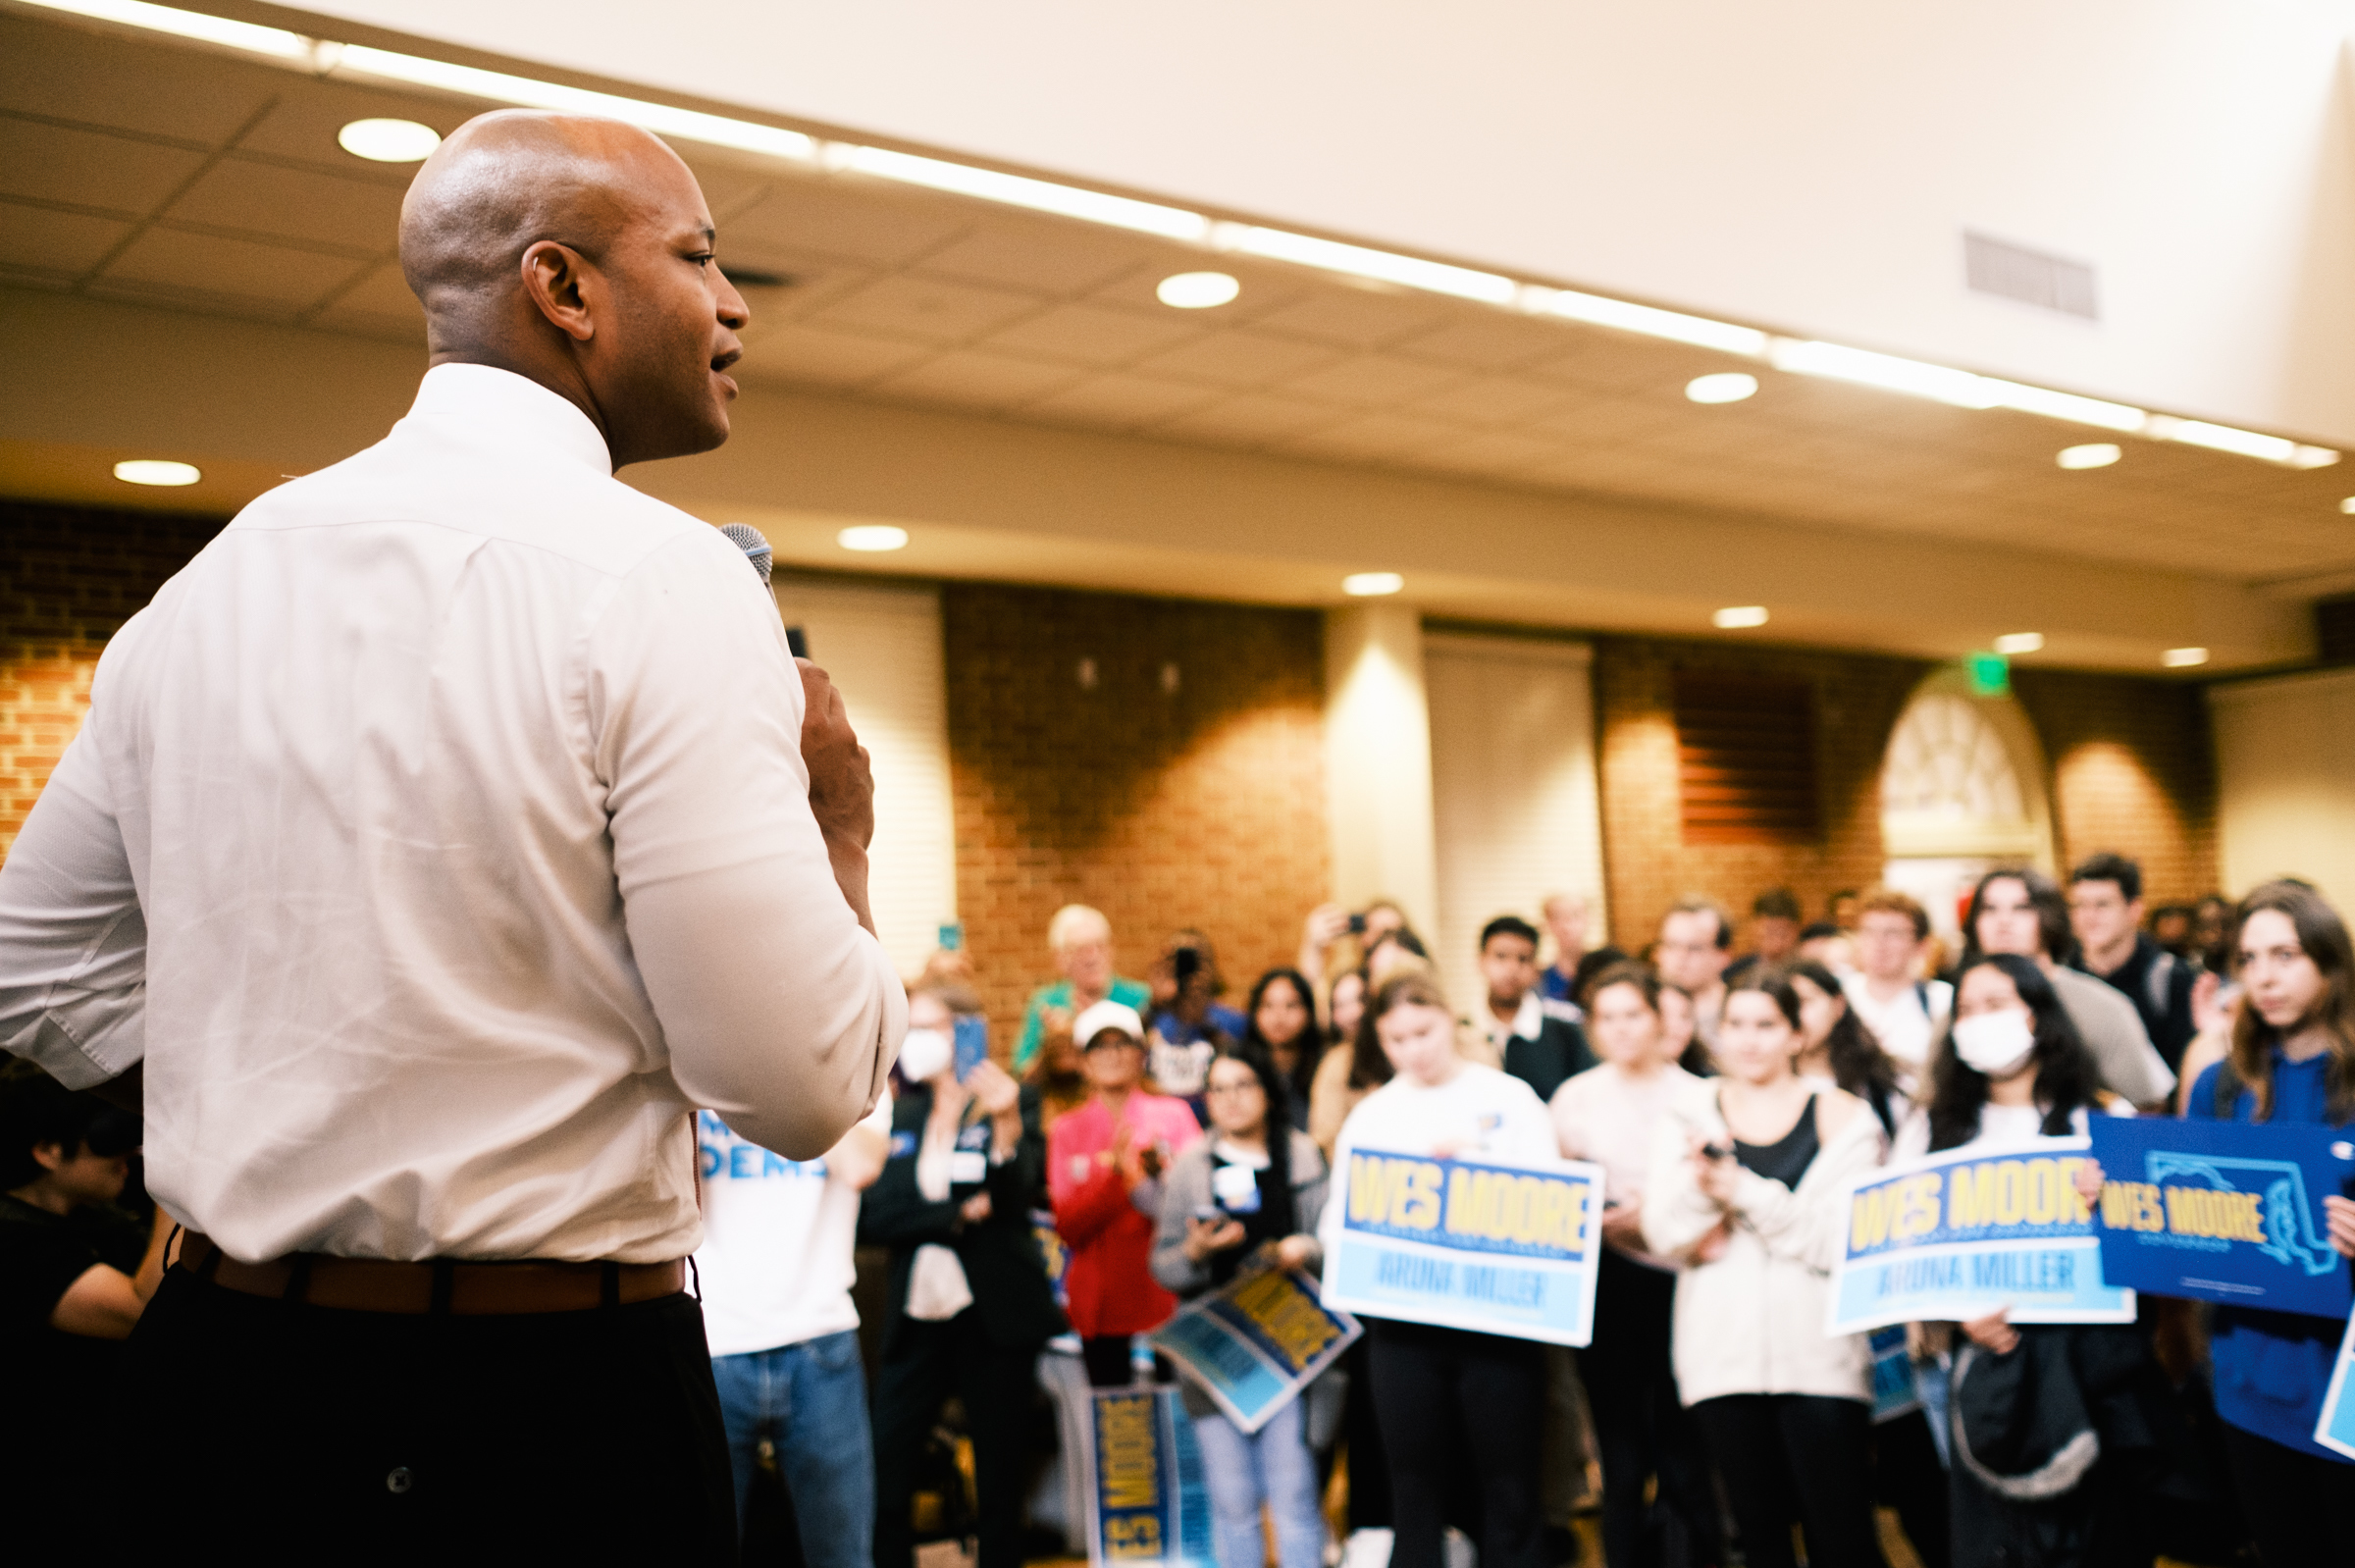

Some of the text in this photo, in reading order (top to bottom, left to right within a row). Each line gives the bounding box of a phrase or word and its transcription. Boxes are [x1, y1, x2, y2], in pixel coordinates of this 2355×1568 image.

[1348, 1152, 1443, 1230] WES
[1444, 1166, 1590, 1253] MOORE
[1849, 1156, 2092, 1252] WES MOOR
[2100, 1179, 2269, 1244] WES MOORE
[1971, 1248, 2076, 1293] MILLER
[1103, 1514, 1162, 1558] ES
